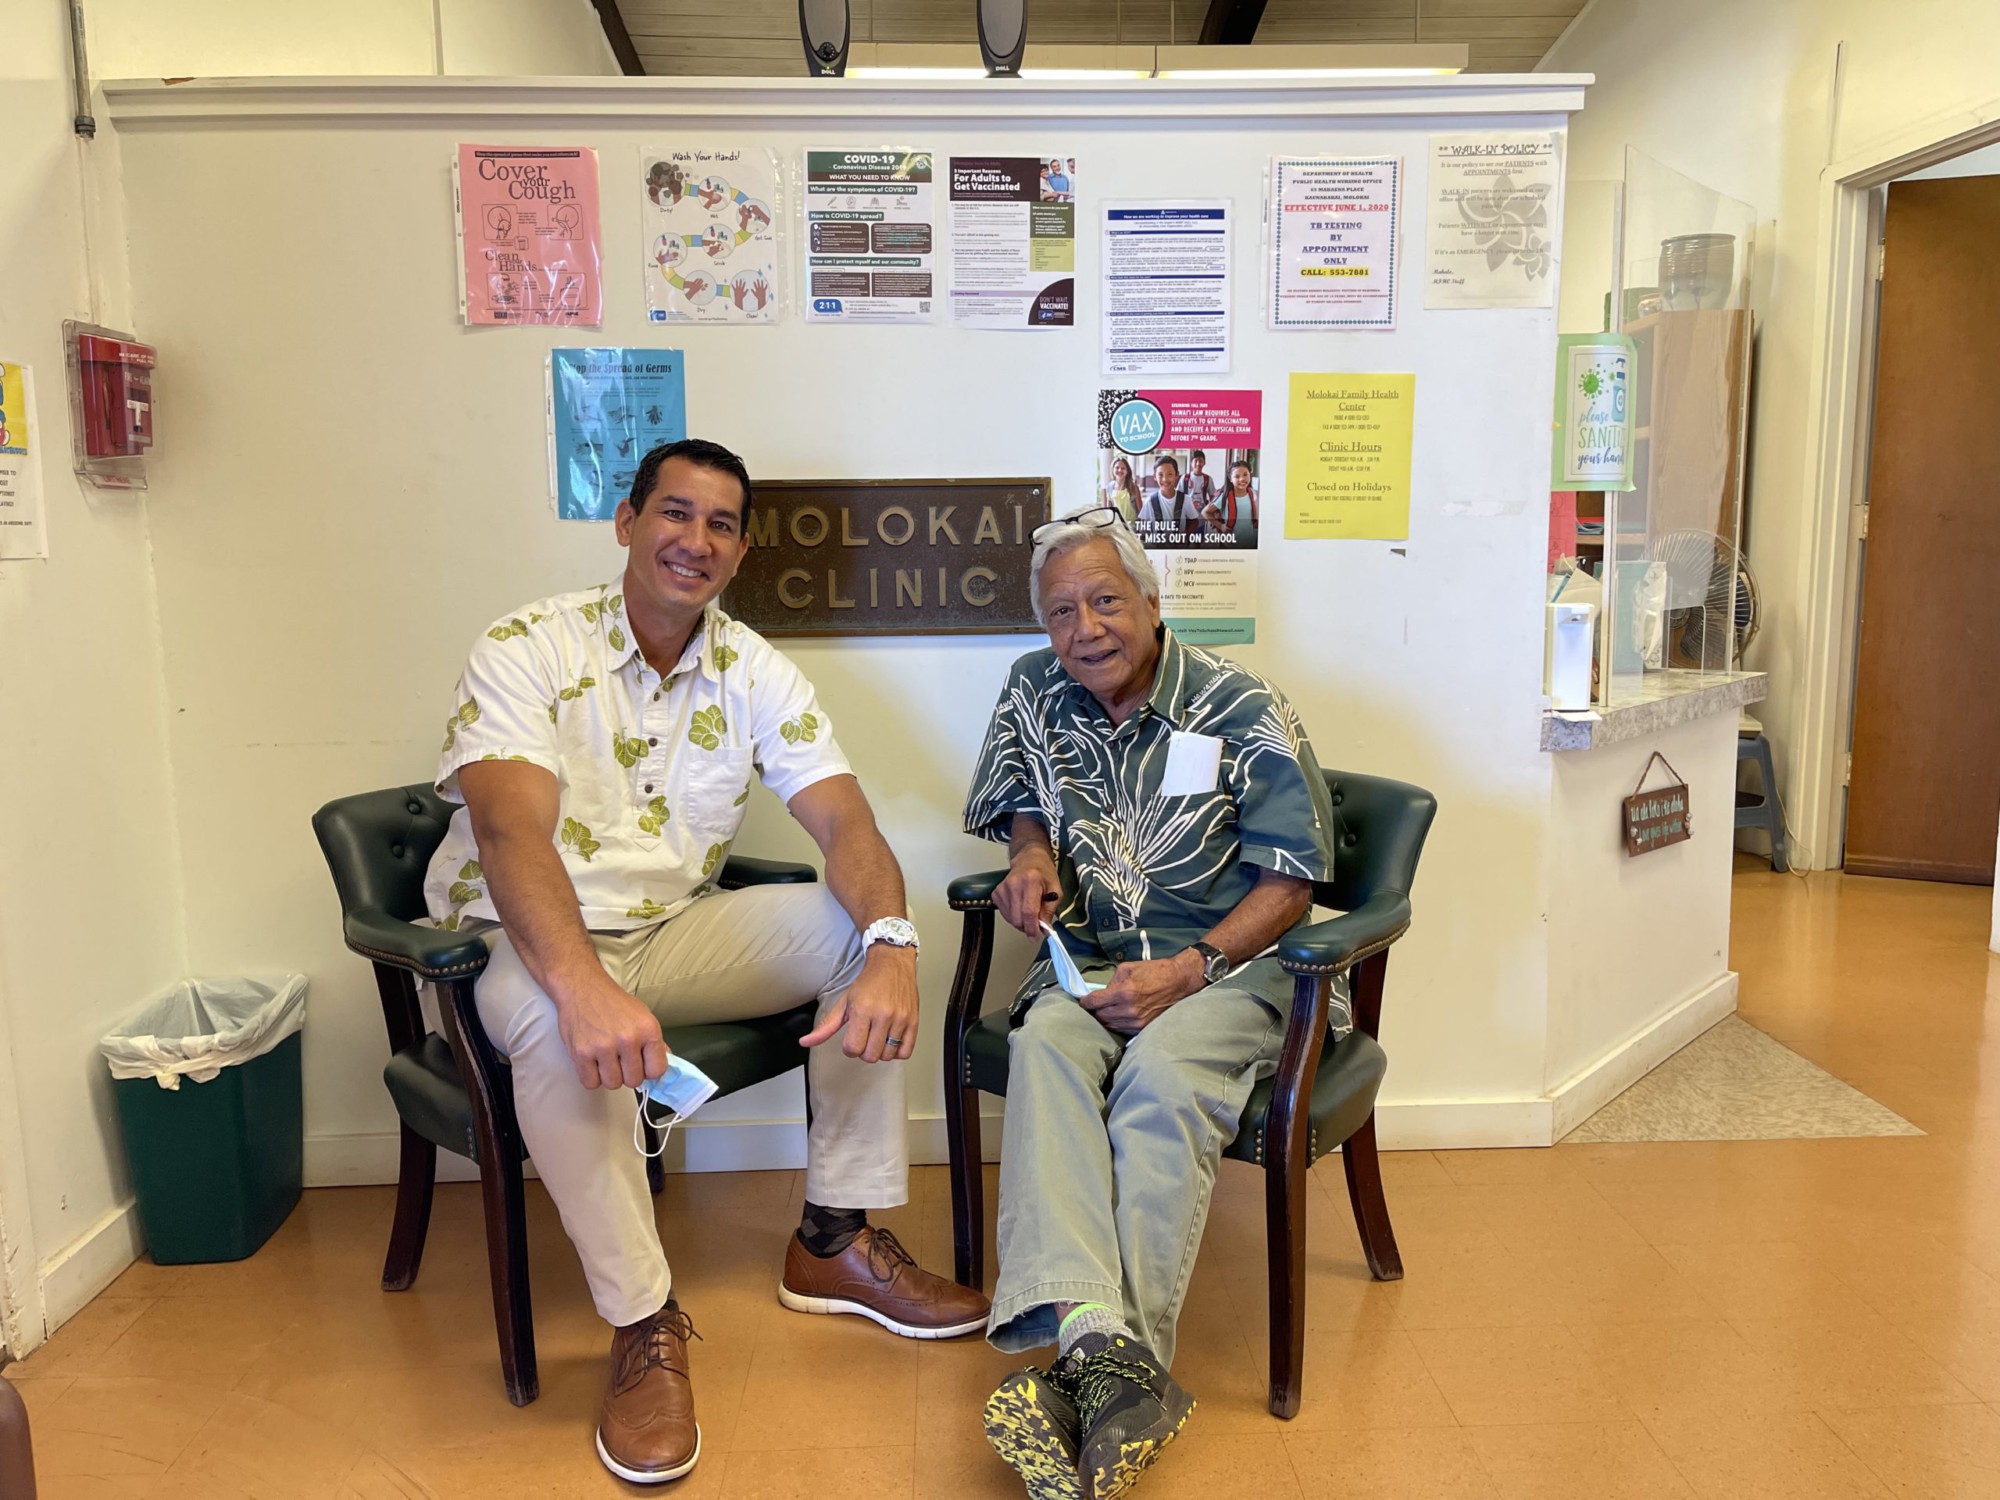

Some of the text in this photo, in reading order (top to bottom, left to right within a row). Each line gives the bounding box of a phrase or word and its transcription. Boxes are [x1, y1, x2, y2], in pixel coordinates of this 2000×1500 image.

[1451, 144, 1539, 155] WALK-IN POLICY
[672, 150, 740, 162] Wash Your Hands!
[844, 155, 895, 164] COVID-19
[479, 158, 548, 181] Cover
[522, 178, 550, 189] your
[971, 174, 1000, 182] Adults
[509, 180, 576, 204] Cough
[954, 182, 1020, 191] Get Vaccinated
[485, 250, 519, 261] Clean
[499, 260, 537, 272] Hands
[635, 364, 643, 373] of
[646, 364, 672, 373] Germs
[1307, 390, 1399, 400] Molokai Family Health
[1339, 402, 1366, 411] Center
[1578, 406, 1608, 427] please
[1119, 411, 1154, 435] VAX
[1130, 432, 1156, 442] SCHOOL
[1319, 442, 1382, 452] Clinic Hours
[1578, 453, 1601, 470] your
[1307, 482, 1336, 491] Closed
[1353, 482, 1391, 493] Holidays
[748, 505, 1023, 548] MOLOKAI
[1135, 521, 1151, 531] THE
[1145, 533, 1166, 543] MISS
[1169, 533, 1187, 543] OUT
[1189, 533, 1201, 543] ON
[1204, 533, 1236, 543] SCHOOL
[777, 566, 999, 609] CLINIC
